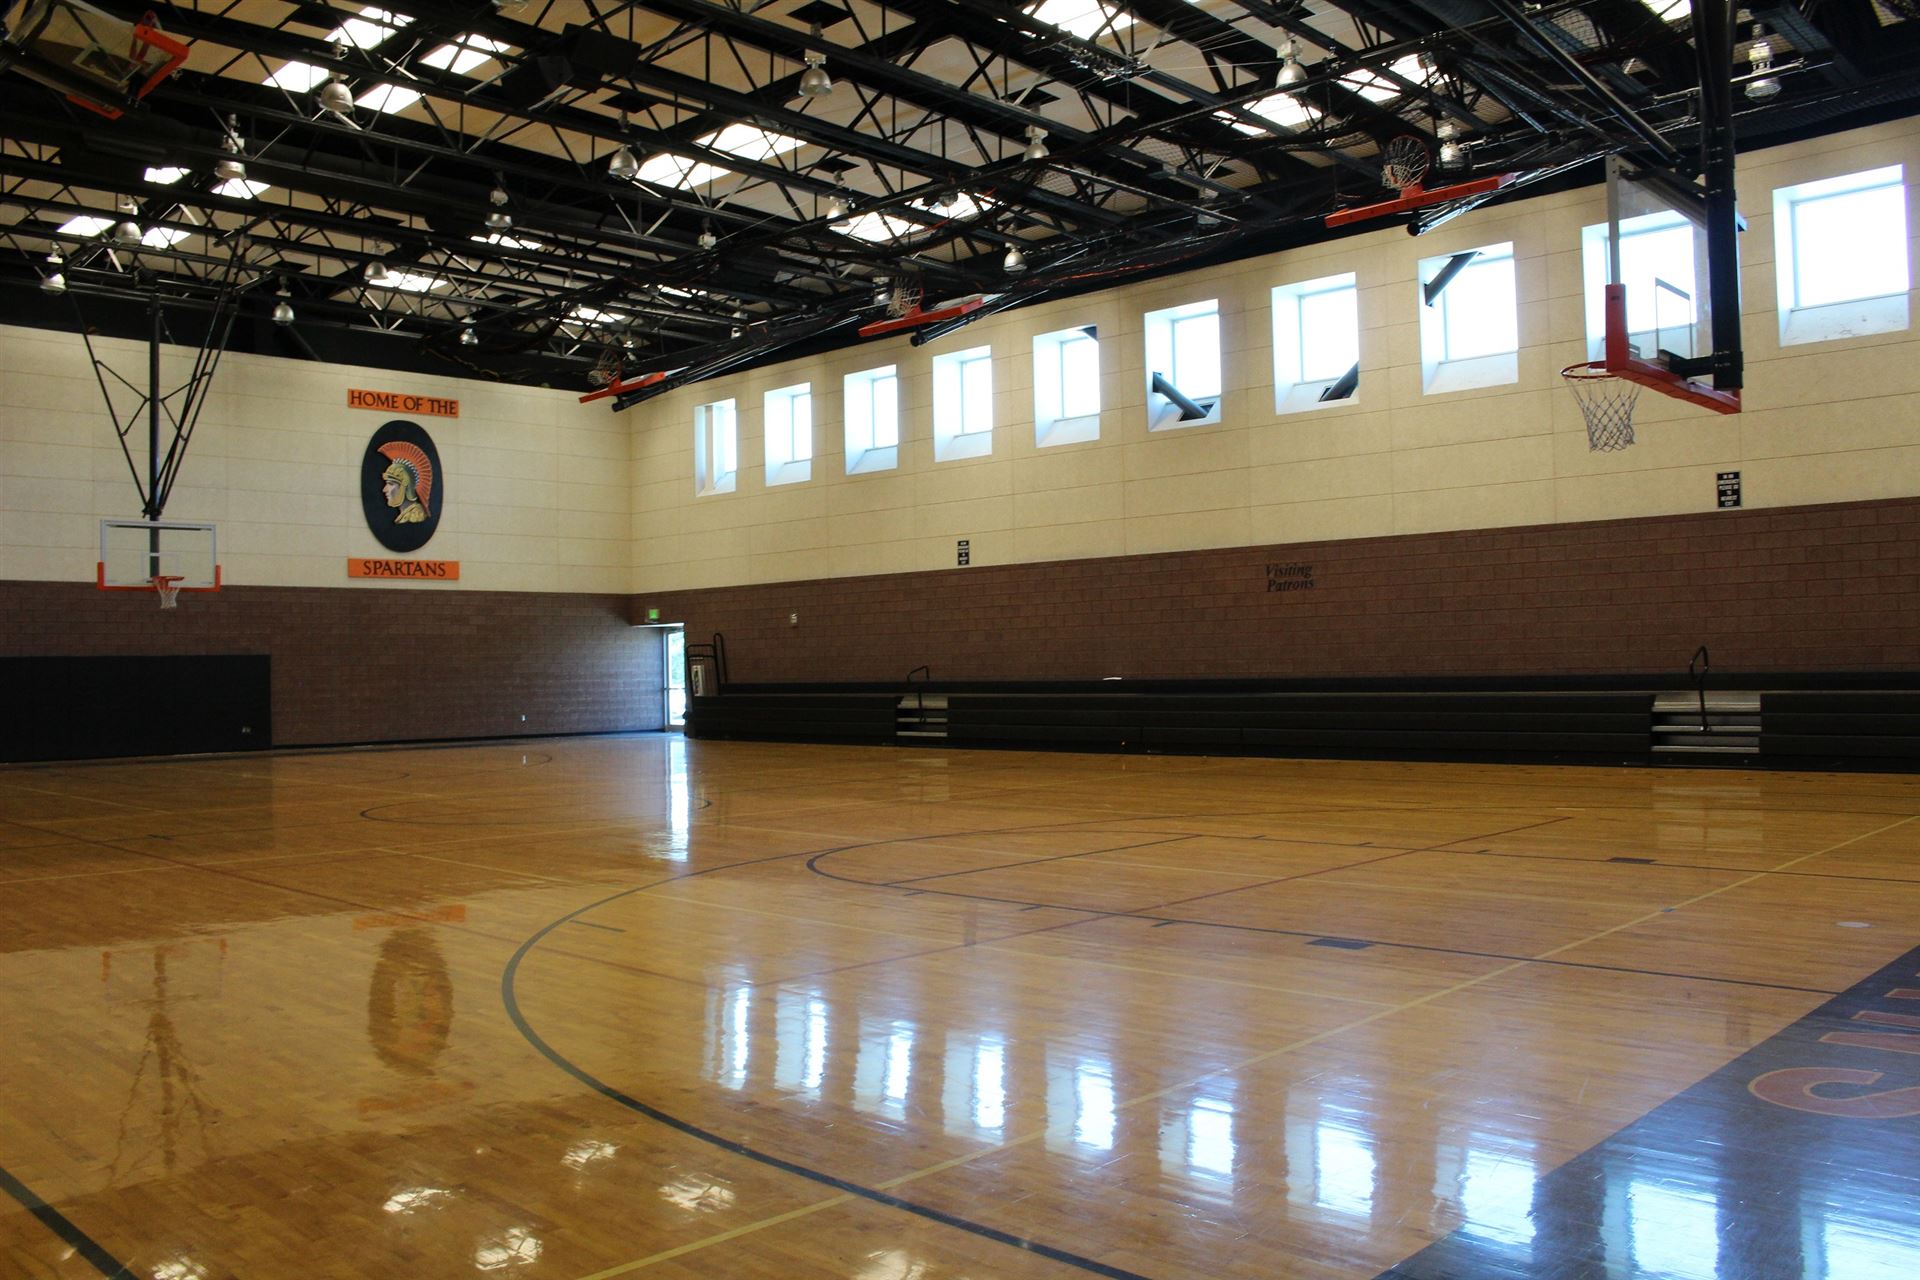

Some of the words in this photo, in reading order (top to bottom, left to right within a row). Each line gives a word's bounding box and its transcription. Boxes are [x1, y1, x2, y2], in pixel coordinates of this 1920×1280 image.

[350, 390, 399, 409] HOME
[403, 396, 422, 411] OF
[427, 399, 456, 415] THE
[363, 560, 446, 577] SPARTANS
[1264, 563, 1313, 579] Visiting
[1266, 578, 1315, 593] Patrons
